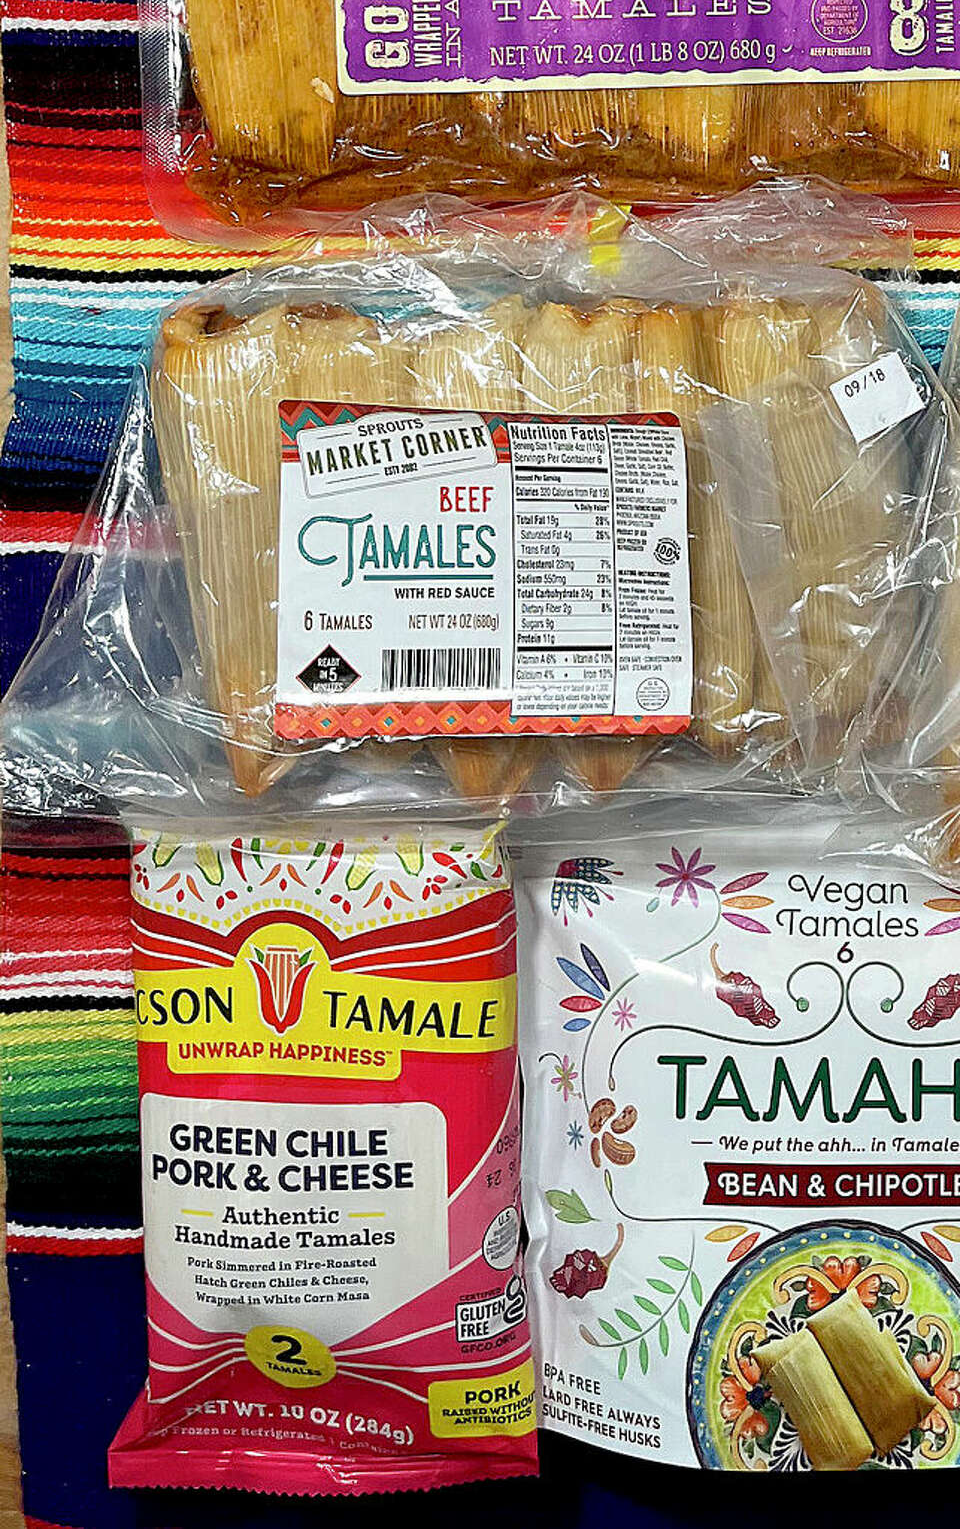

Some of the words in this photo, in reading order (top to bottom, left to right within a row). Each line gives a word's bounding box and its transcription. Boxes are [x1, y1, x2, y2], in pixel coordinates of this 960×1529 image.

[843, 368, 887, 399] 09/18
[358, 417, 424, 438] SPROUTS
[511, 426, 563, 440] Nutrition
[567, 427, 605, 441] Facts
[307, 438, 395, 478] MARKET
[401, 425, 486, 464] CORNER
[440, 486, 493, 513] BEEF
[298, 513, 496, 587] TAMALES
[394, 588, 426, 600] WITH
[430, 587, 452, 599] RED
[456, 586, 494, 598] SAUCE
[304, 611, 313, 631] 6
[319, 613, 372, 630] TAMALES
[787, 875, 908, 908] Vegan
[776, 909, 918, 938] Tamales
[837, 941, 855, 964] 6
[322, 990, 498, 1038] TAMALE
[179, 1043, 264, 1059] UNWRAP
[270, 1043, 388, 1067] HAPPINESS
[169, 1124, 277, 1157] GREEN
[287, 1129, 388, 1157] CHILE
[719, 1135, 749, 1152] We
[754, 1138, 782, 1155] put
[787, 1135, 814, 1152] the
[817, 1135, 865, 1152] ahh...
[871, 1135, 887, 1152] in
[152, 1154, 235, 1190] PORK
[243, 1165, 268, 1189] &
[278, 1162, 414, 1192] CHEESE
[718, 1173, 799, 1196] BEAN
[807, 1174, 827, 1196] &
[222, 1207, 339, 1225] Authentic
[175, 1227, 290, 1249] Handmade
[296, 1227, 395, 1248] Tamales
[271, 1335, 308, 1365] 2
[465, 1381, 521, 1404] PORK
